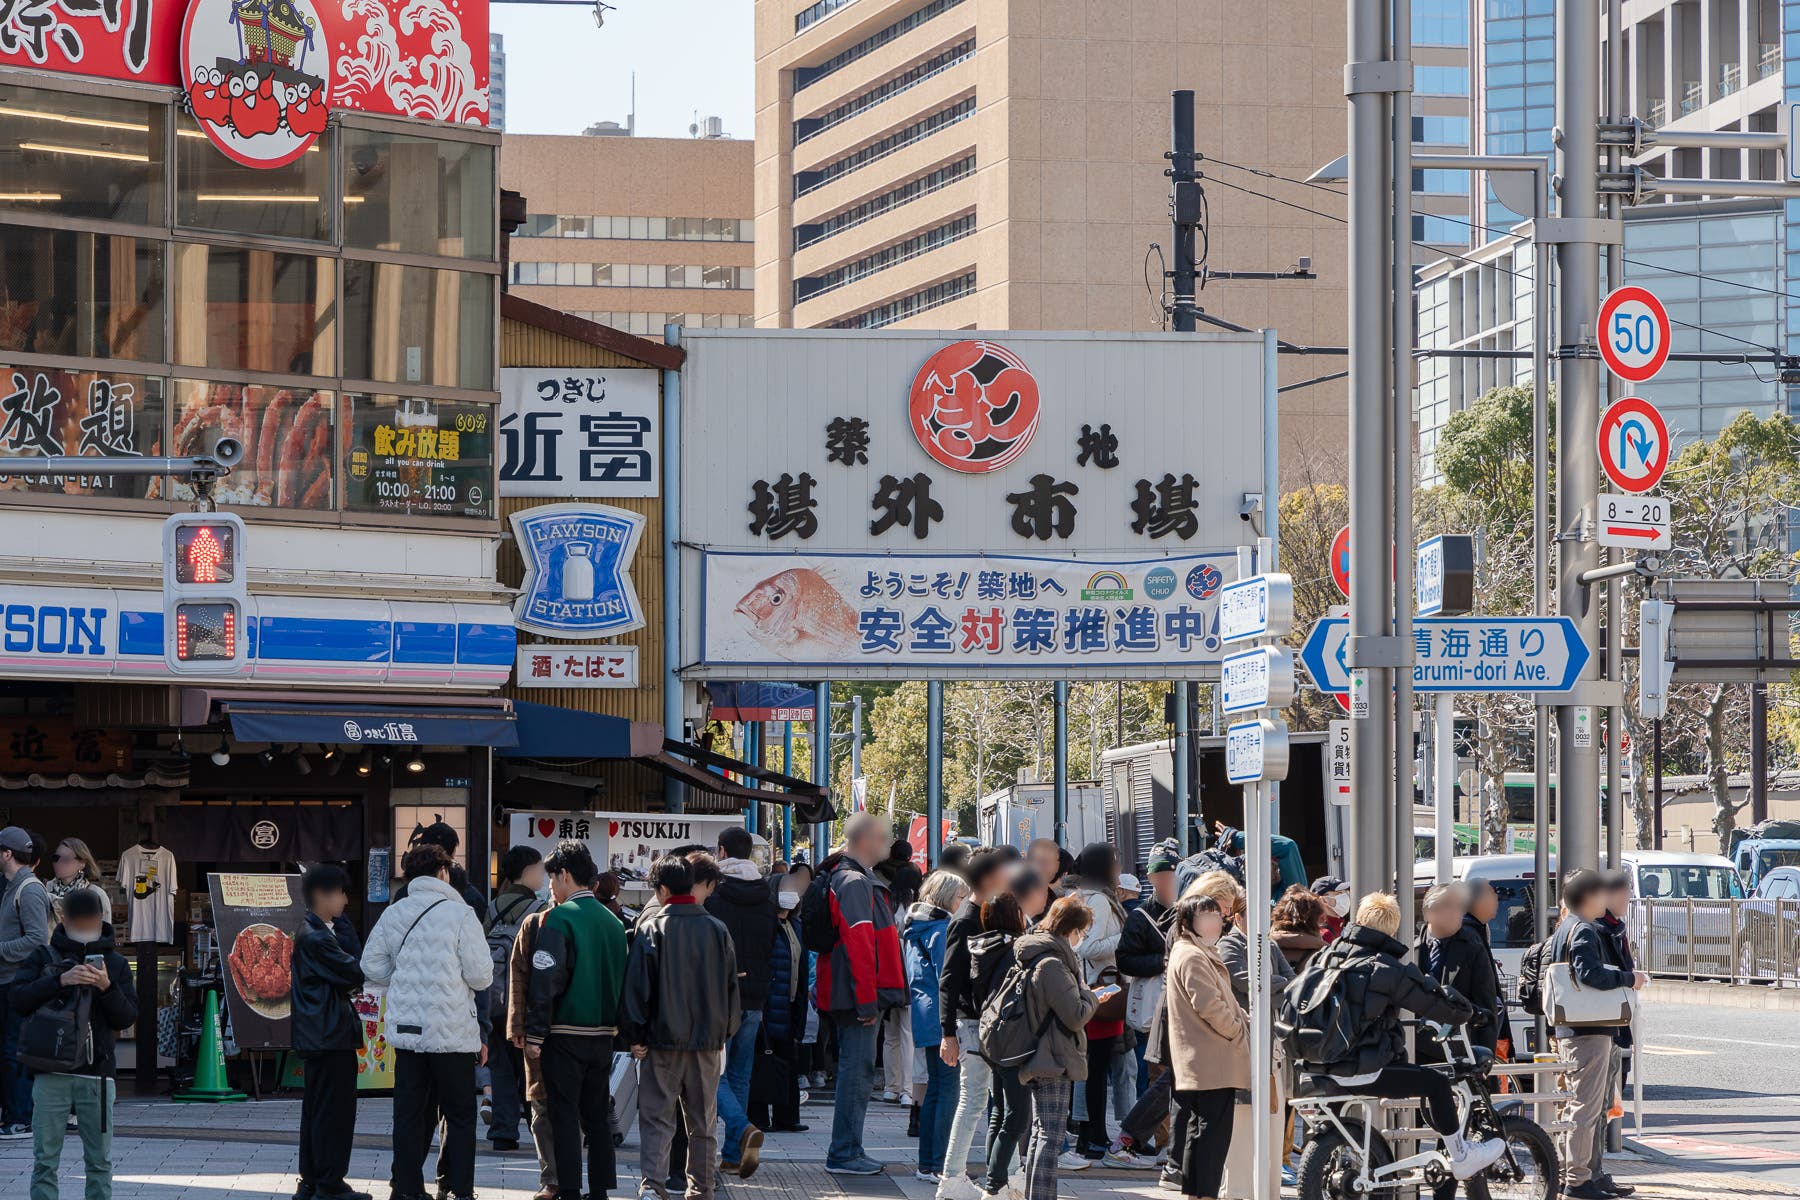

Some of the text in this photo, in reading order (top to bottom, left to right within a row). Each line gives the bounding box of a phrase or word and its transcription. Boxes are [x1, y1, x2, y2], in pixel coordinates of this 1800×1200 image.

[1614, 313, 1653, 355] 50
[536, 376, 607, 404] つきじ
[456, 413, 486, 432] 60分
[374, 425, 460, 460] 飲み放題
[500, 412, 651, 482] 近富
[397, 460, 409, 468] you
[426, 460, 445, 468] drink
[376, 481, 409, 498] 10:00
[424, 484, 455, 501] 21:00
[433, 503, 452, 511] 20:00
[748, 472, 1200, 541] 場外市場
[1642, 505, 1661, 522] 20
[532, 521, 623, 545] LAWSON
[1147, 575, 1175, 585] SAFETY
[1151, 587, 1170, 596] CHUO
[532, 598, 624, 619] STATION
[0, 604, 107, 654] SON
[1413, 660, 1550, 682] arumi-dori Ave.
[528, 817, 590, 840] I 東京
[621, 821, 690, 840] TSUKIJI
